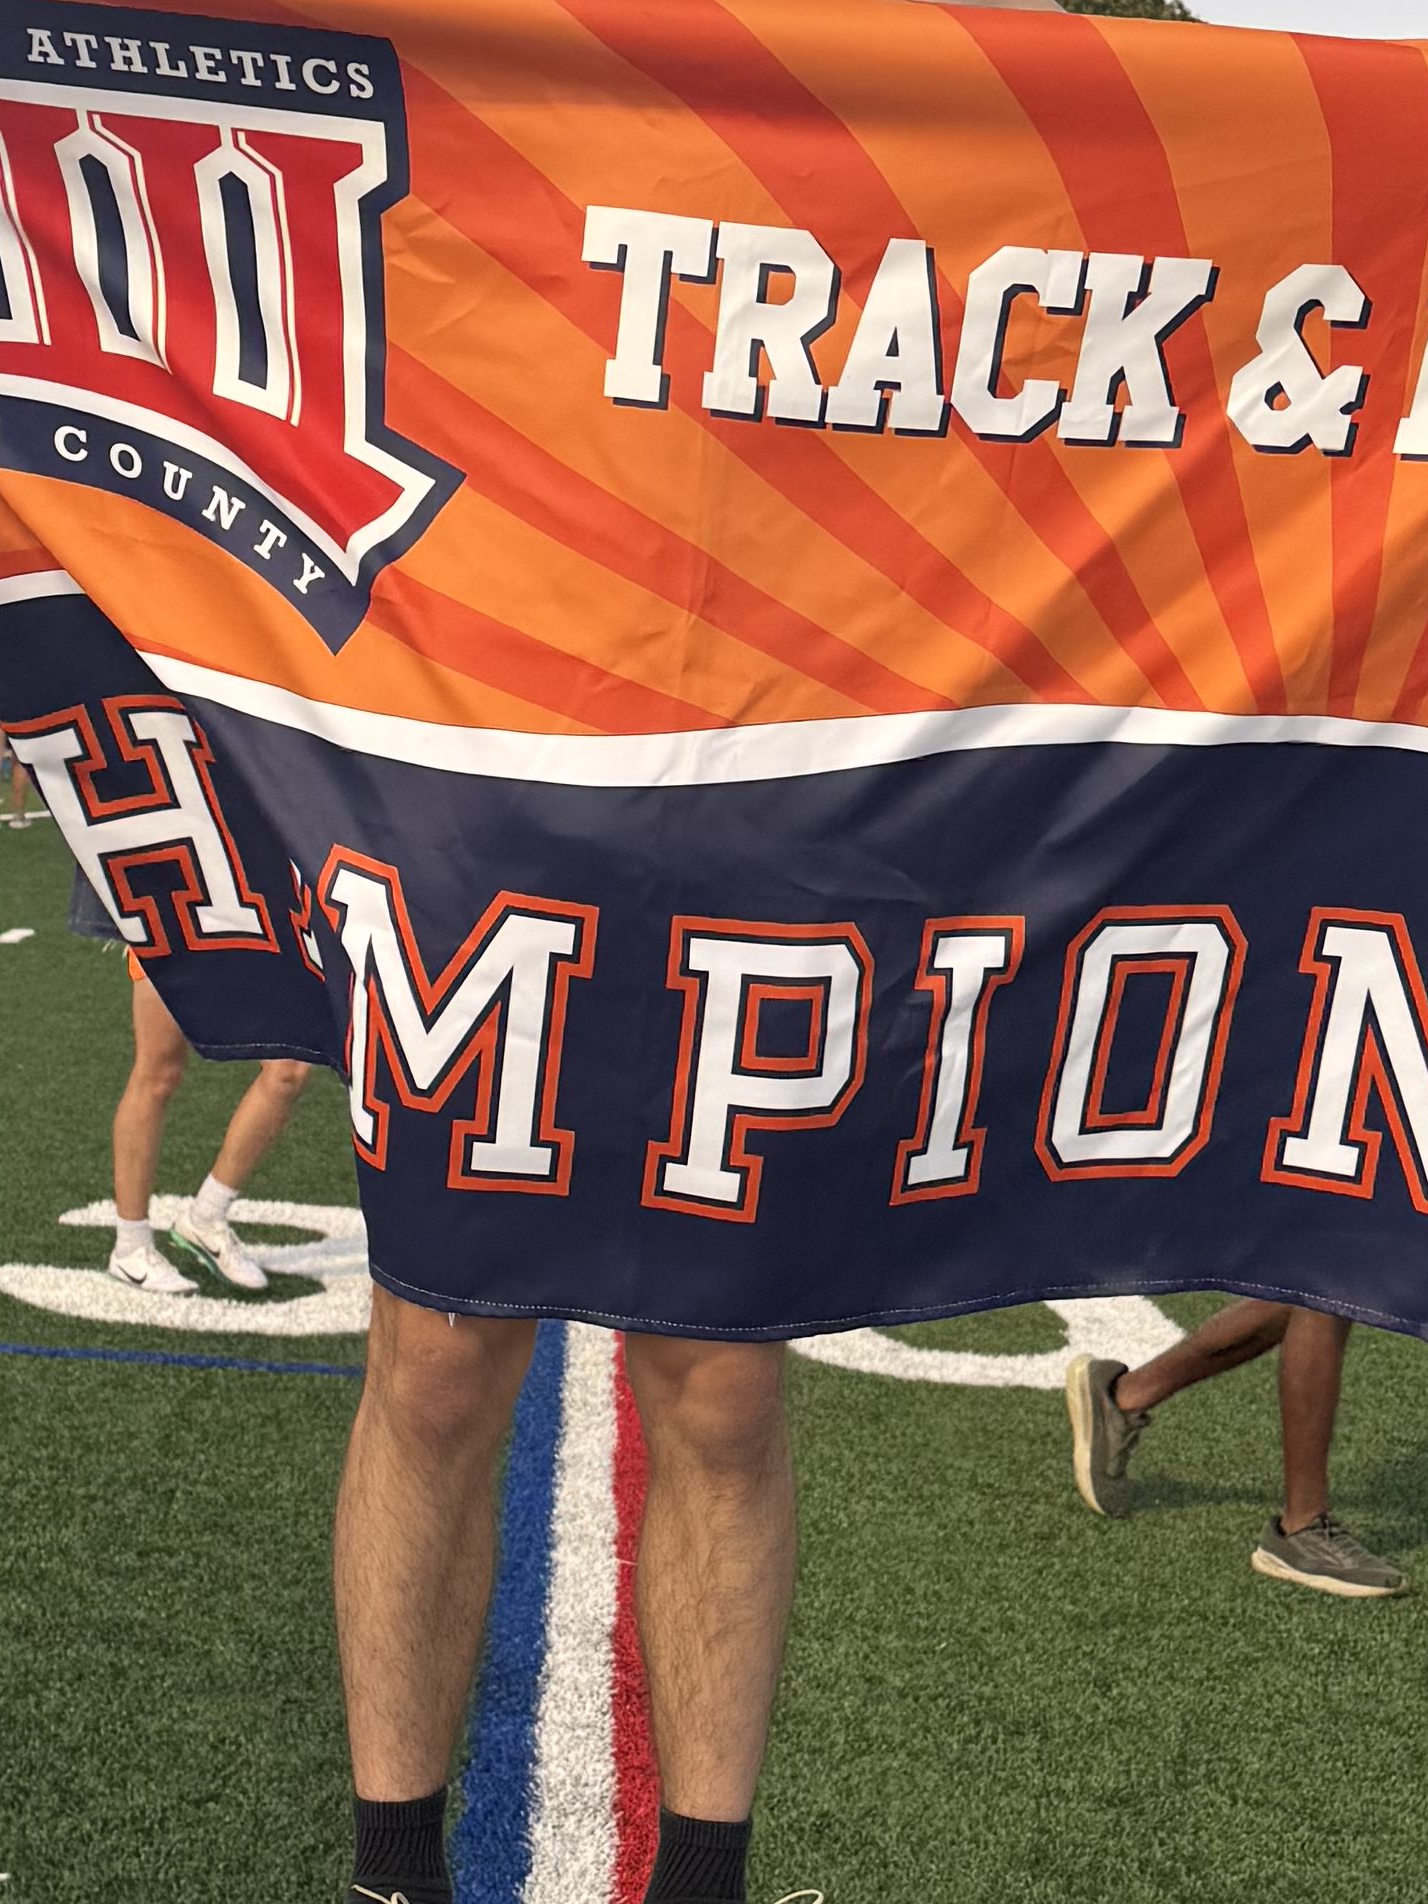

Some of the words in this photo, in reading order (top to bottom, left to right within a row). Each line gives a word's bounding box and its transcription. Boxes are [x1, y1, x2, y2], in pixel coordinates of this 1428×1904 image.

[26, 27, 375, 100] ATHLETICS
[582, 204, 1220, 449] TRACK
[1225, 263, 1372, 457] &
[53, 425, 326, 594] COUNTY
